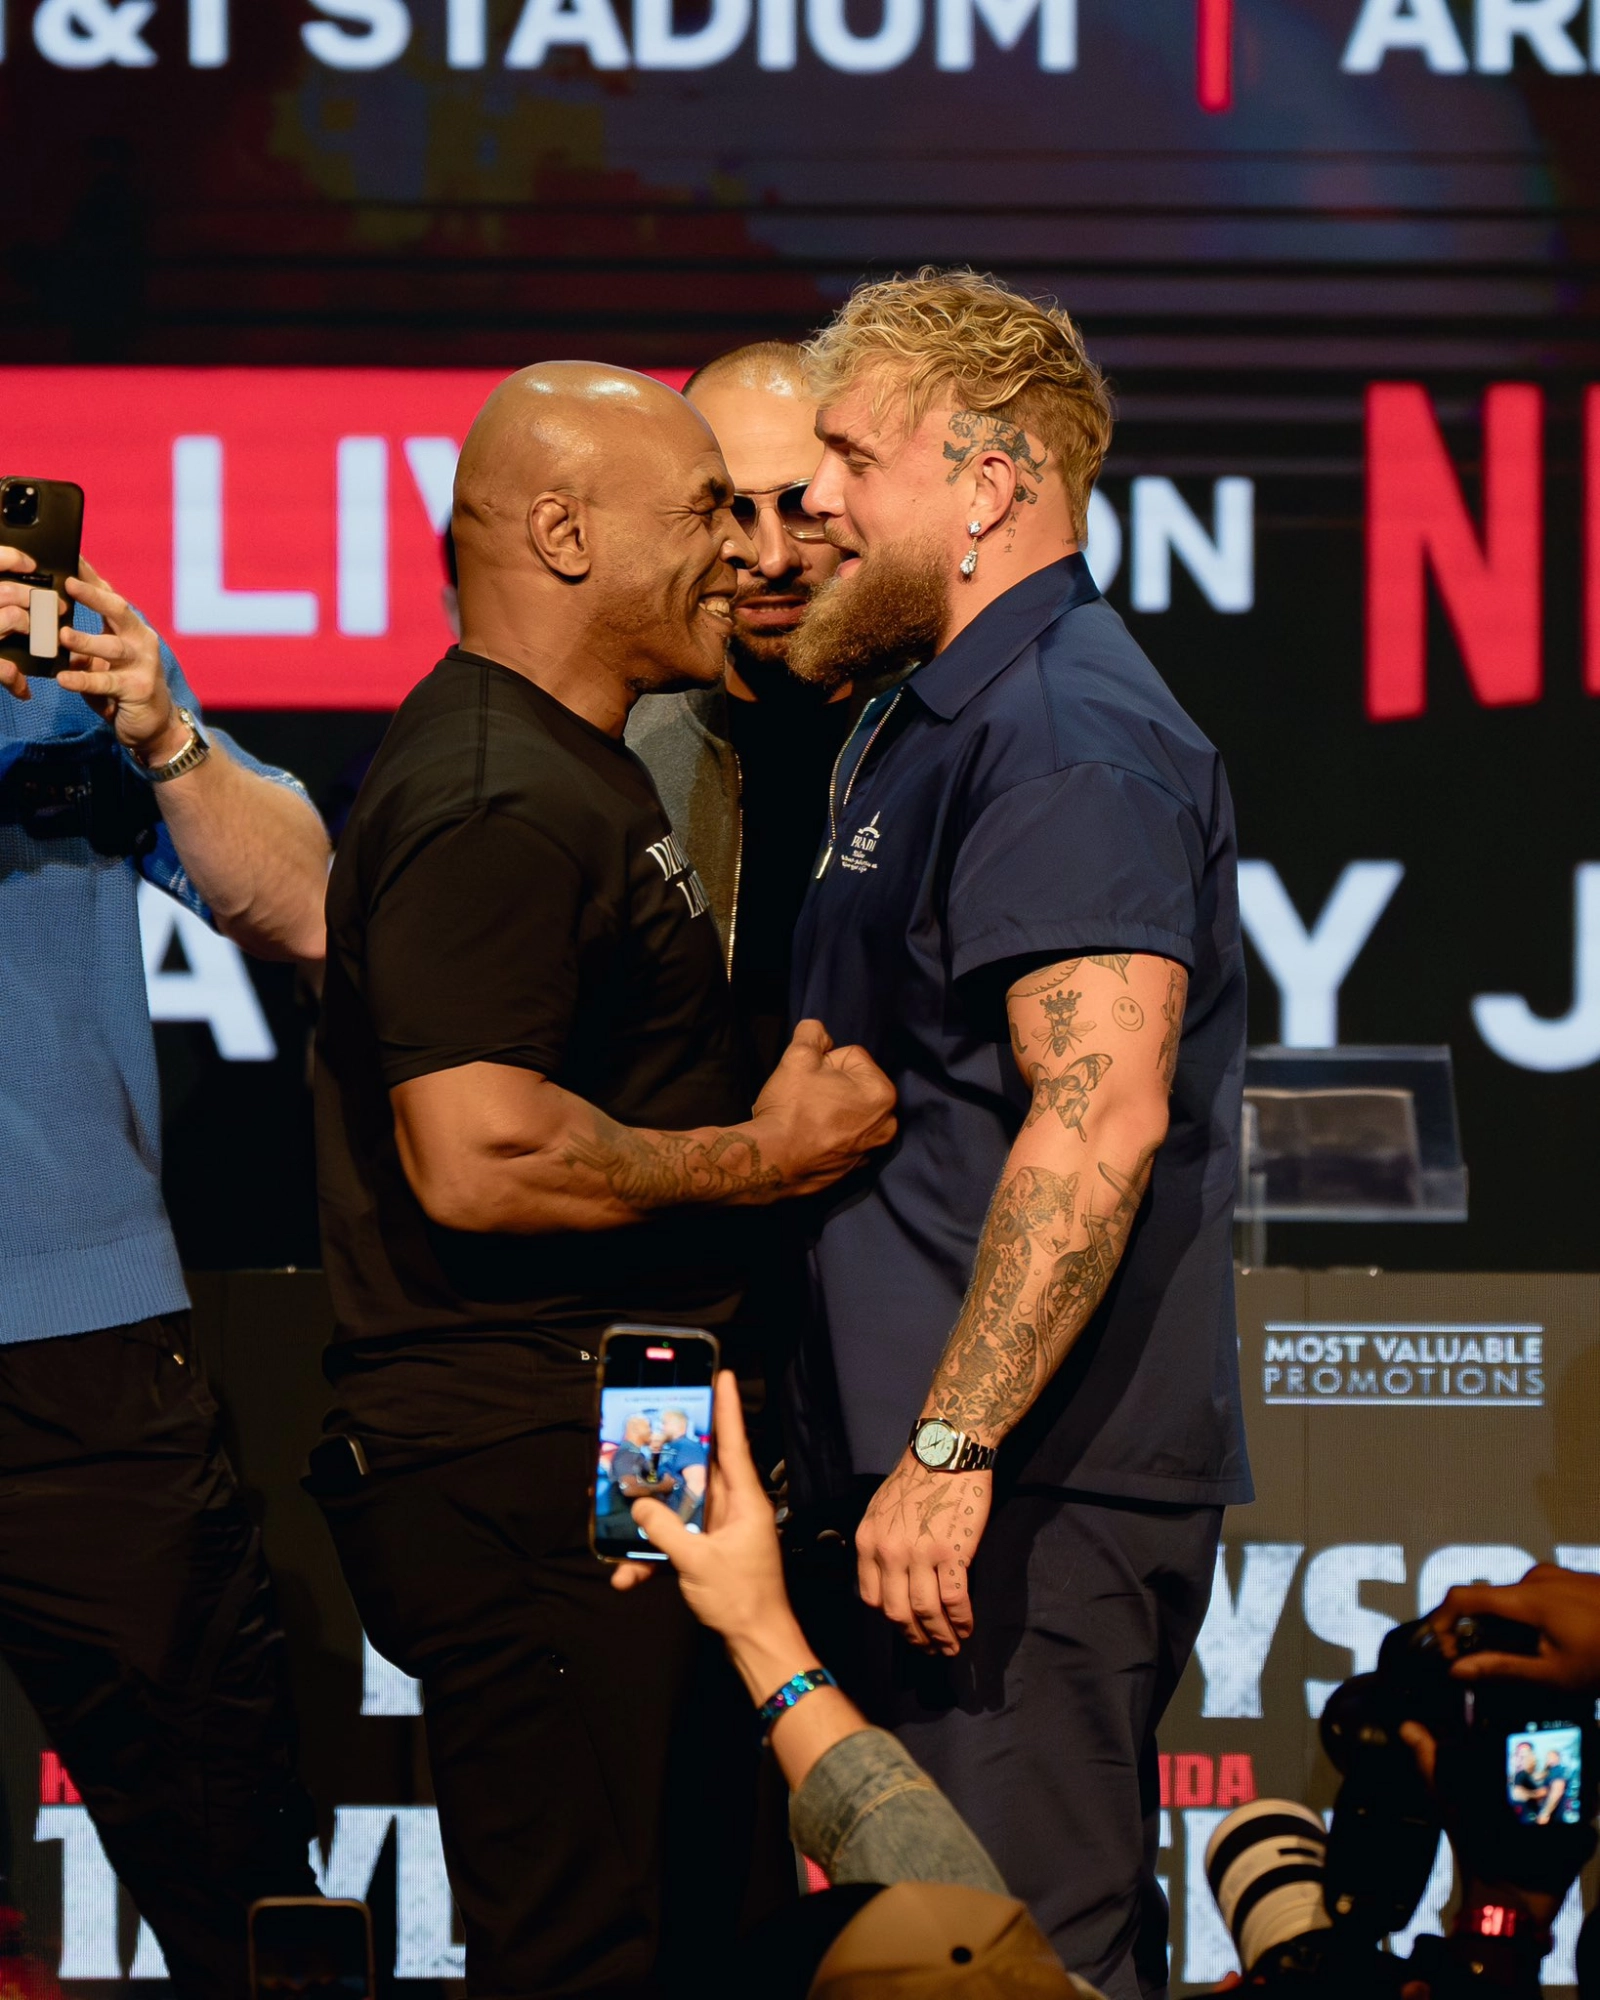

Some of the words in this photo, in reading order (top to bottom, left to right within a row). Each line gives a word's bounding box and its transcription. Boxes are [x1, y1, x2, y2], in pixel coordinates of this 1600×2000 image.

[300, 0, 1078, 73] STADIUM
[1340, 0, 1600, 75] AR
[1364, 380, 1600, 722] N
[1264, 1335, 1366, 1363] MOST
[1372, 1335, 1544, 1364] VALUABLE
[1264, 1366, 1546, 1395] PROMOTIONS
